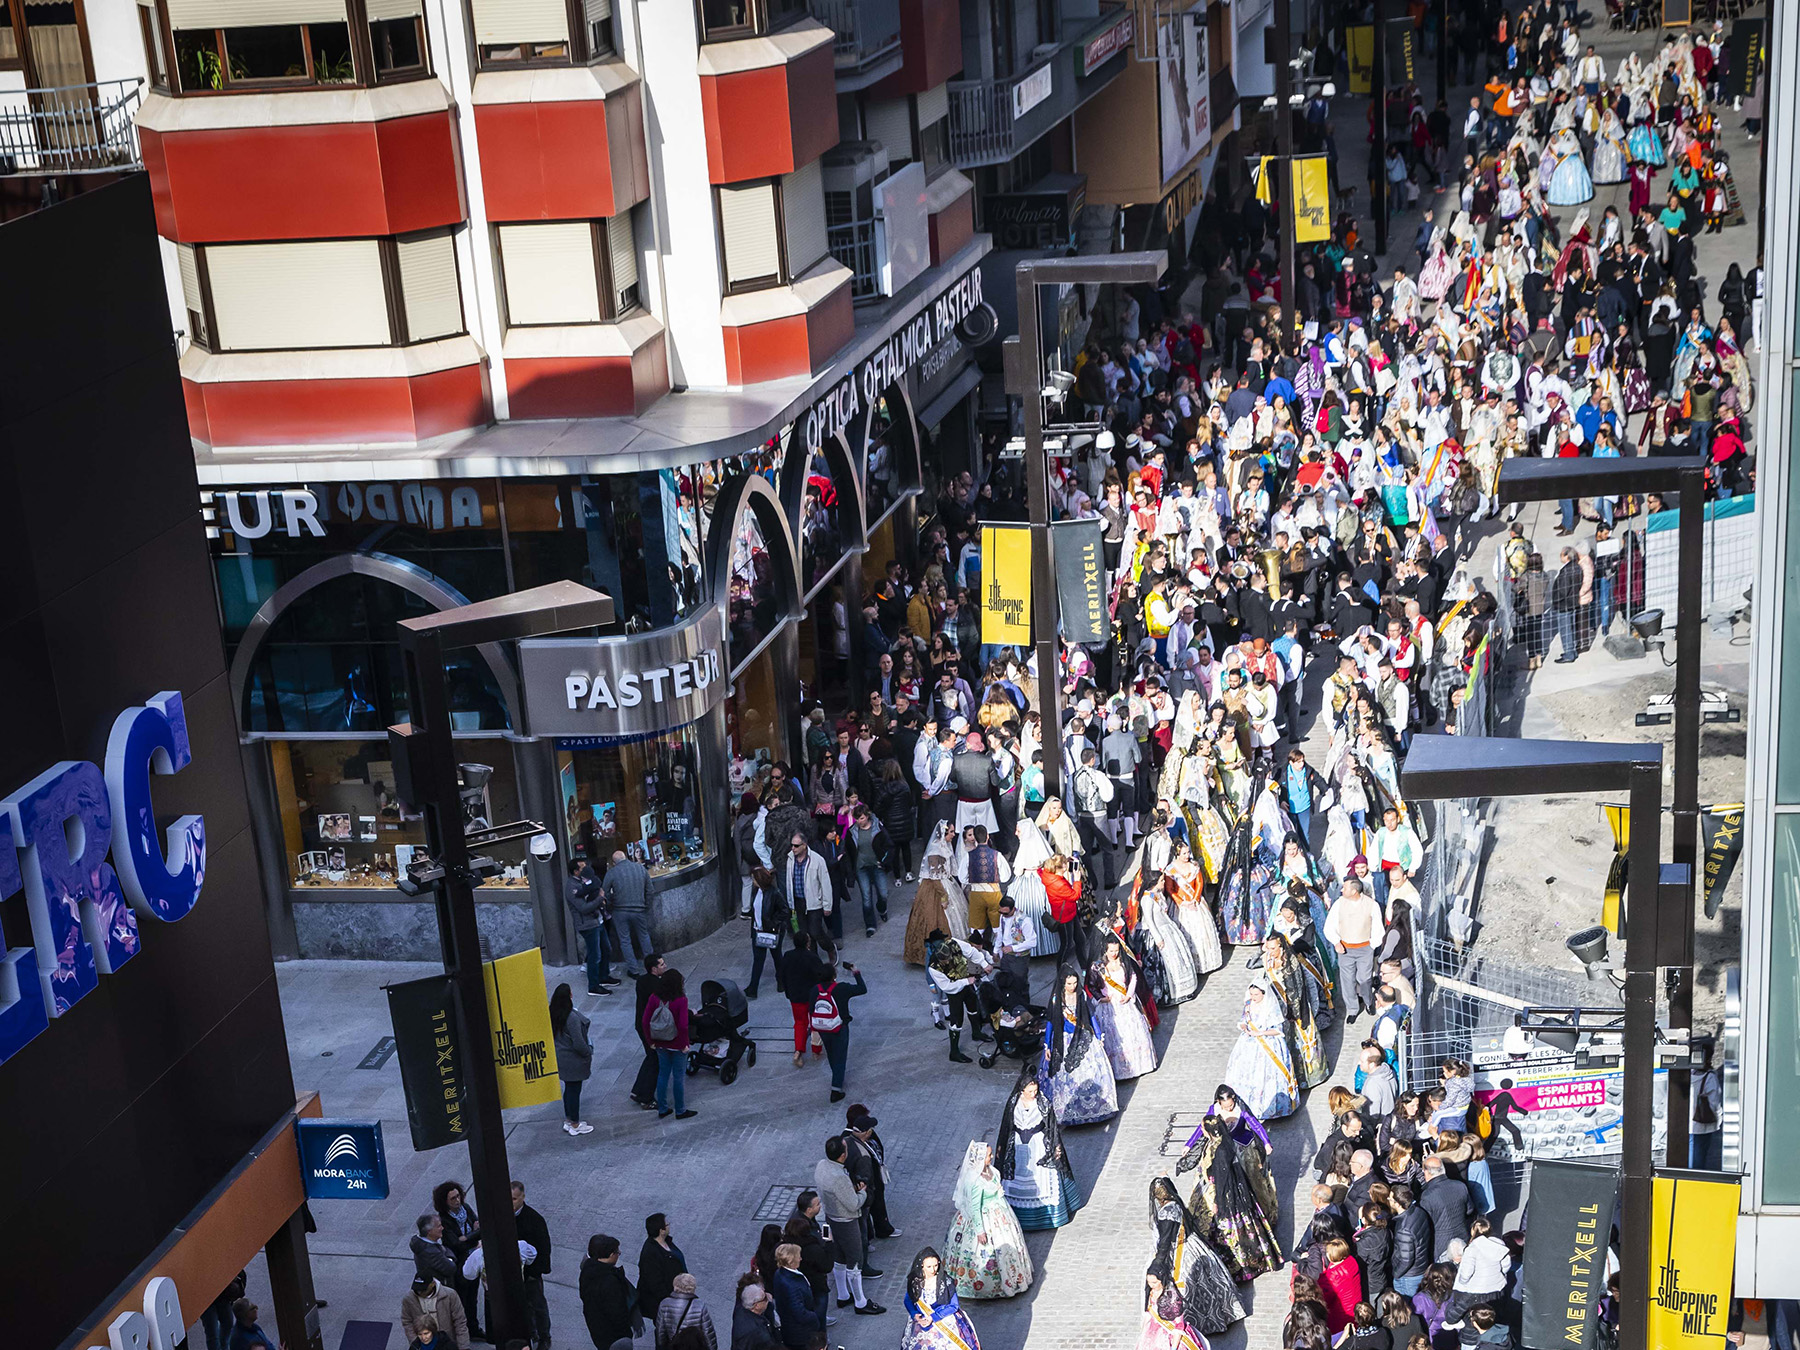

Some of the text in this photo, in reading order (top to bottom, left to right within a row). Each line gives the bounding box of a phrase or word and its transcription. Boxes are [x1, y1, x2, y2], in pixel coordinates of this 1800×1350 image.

[935, 266, 983, 342] PASTEUR
[1083, 542, 1103, 636] MERITXELL
[988, 598, 1024, 613] SHOPPING
[1004, 611, 1021, 626] MILE
[565, 649, 720, 709] PASTEUR
[570, 735, 618, 746] PASTEUR
[666, 811, 679, 819] NEW
[494, 1022, 516, 1048] THE
[497, 1040, 547, 1067] SHOPPING
[431, 1009, 463, 1133] MERITXELL
[522, 1060, 546, 1081] MILE
[1523, 1066, 1553, 1075] FEBRER
[1537, 1081, 1603, 1096] ESPAI PER A
[1537, 1092, 1604, 1108] VIANANTS
[313, 1168, 374, 1179] MORABANC
[346, 1178, 368, 1190] 24h
[1564, 1203, 1599, 1344] MERITXELL
[1659, 1258, 1681, 1290] THE
[1657, 1285, 1718, 1316] SHOPPING
[1682, 1312, 1712, 1336] MILE
